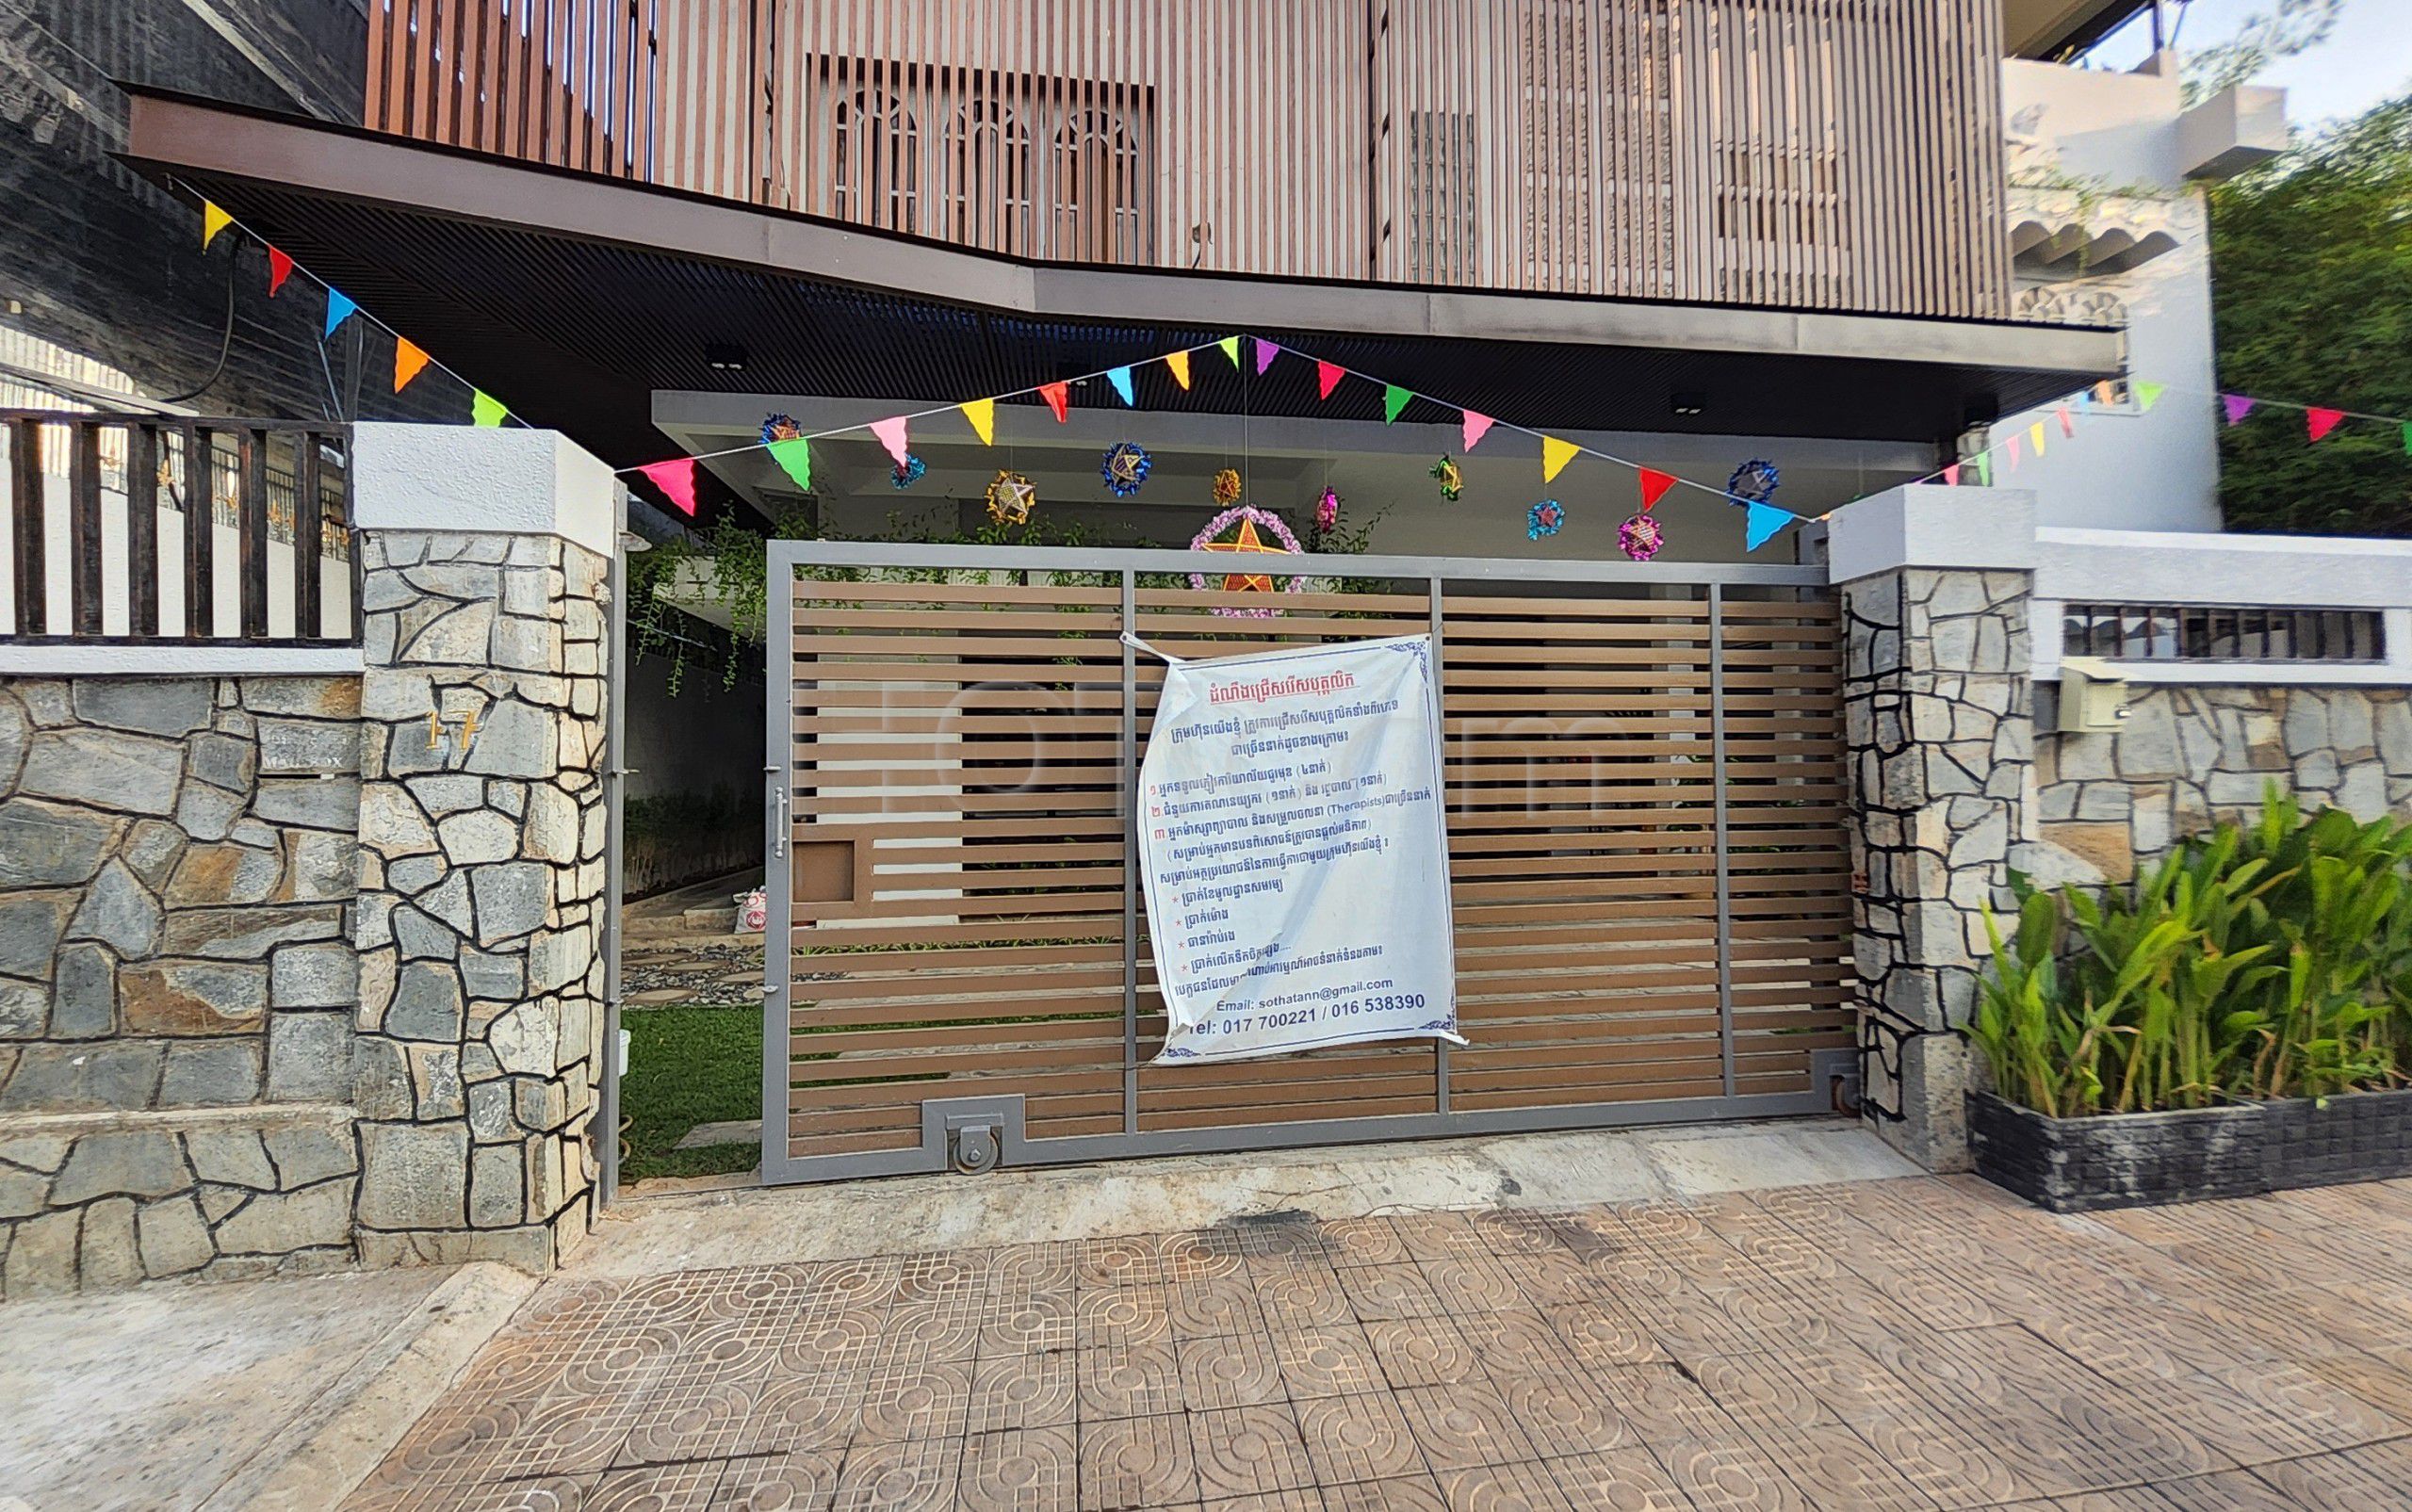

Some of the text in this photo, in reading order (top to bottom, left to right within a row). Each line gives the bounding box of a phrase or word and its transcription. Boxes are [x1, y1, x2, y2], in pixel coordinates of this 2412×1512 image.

[425, 709, 479, 751] 17
[1216, 979, 1393, 1012] Email: sothatann@gmail.com
[1223, 1018, 1252, 1034] 017
[1259, 1008, 1315, 1030] 700221
[1331, 1000, 1359, 1017] 016
[1364, 993, 1426, 1013] 538390
